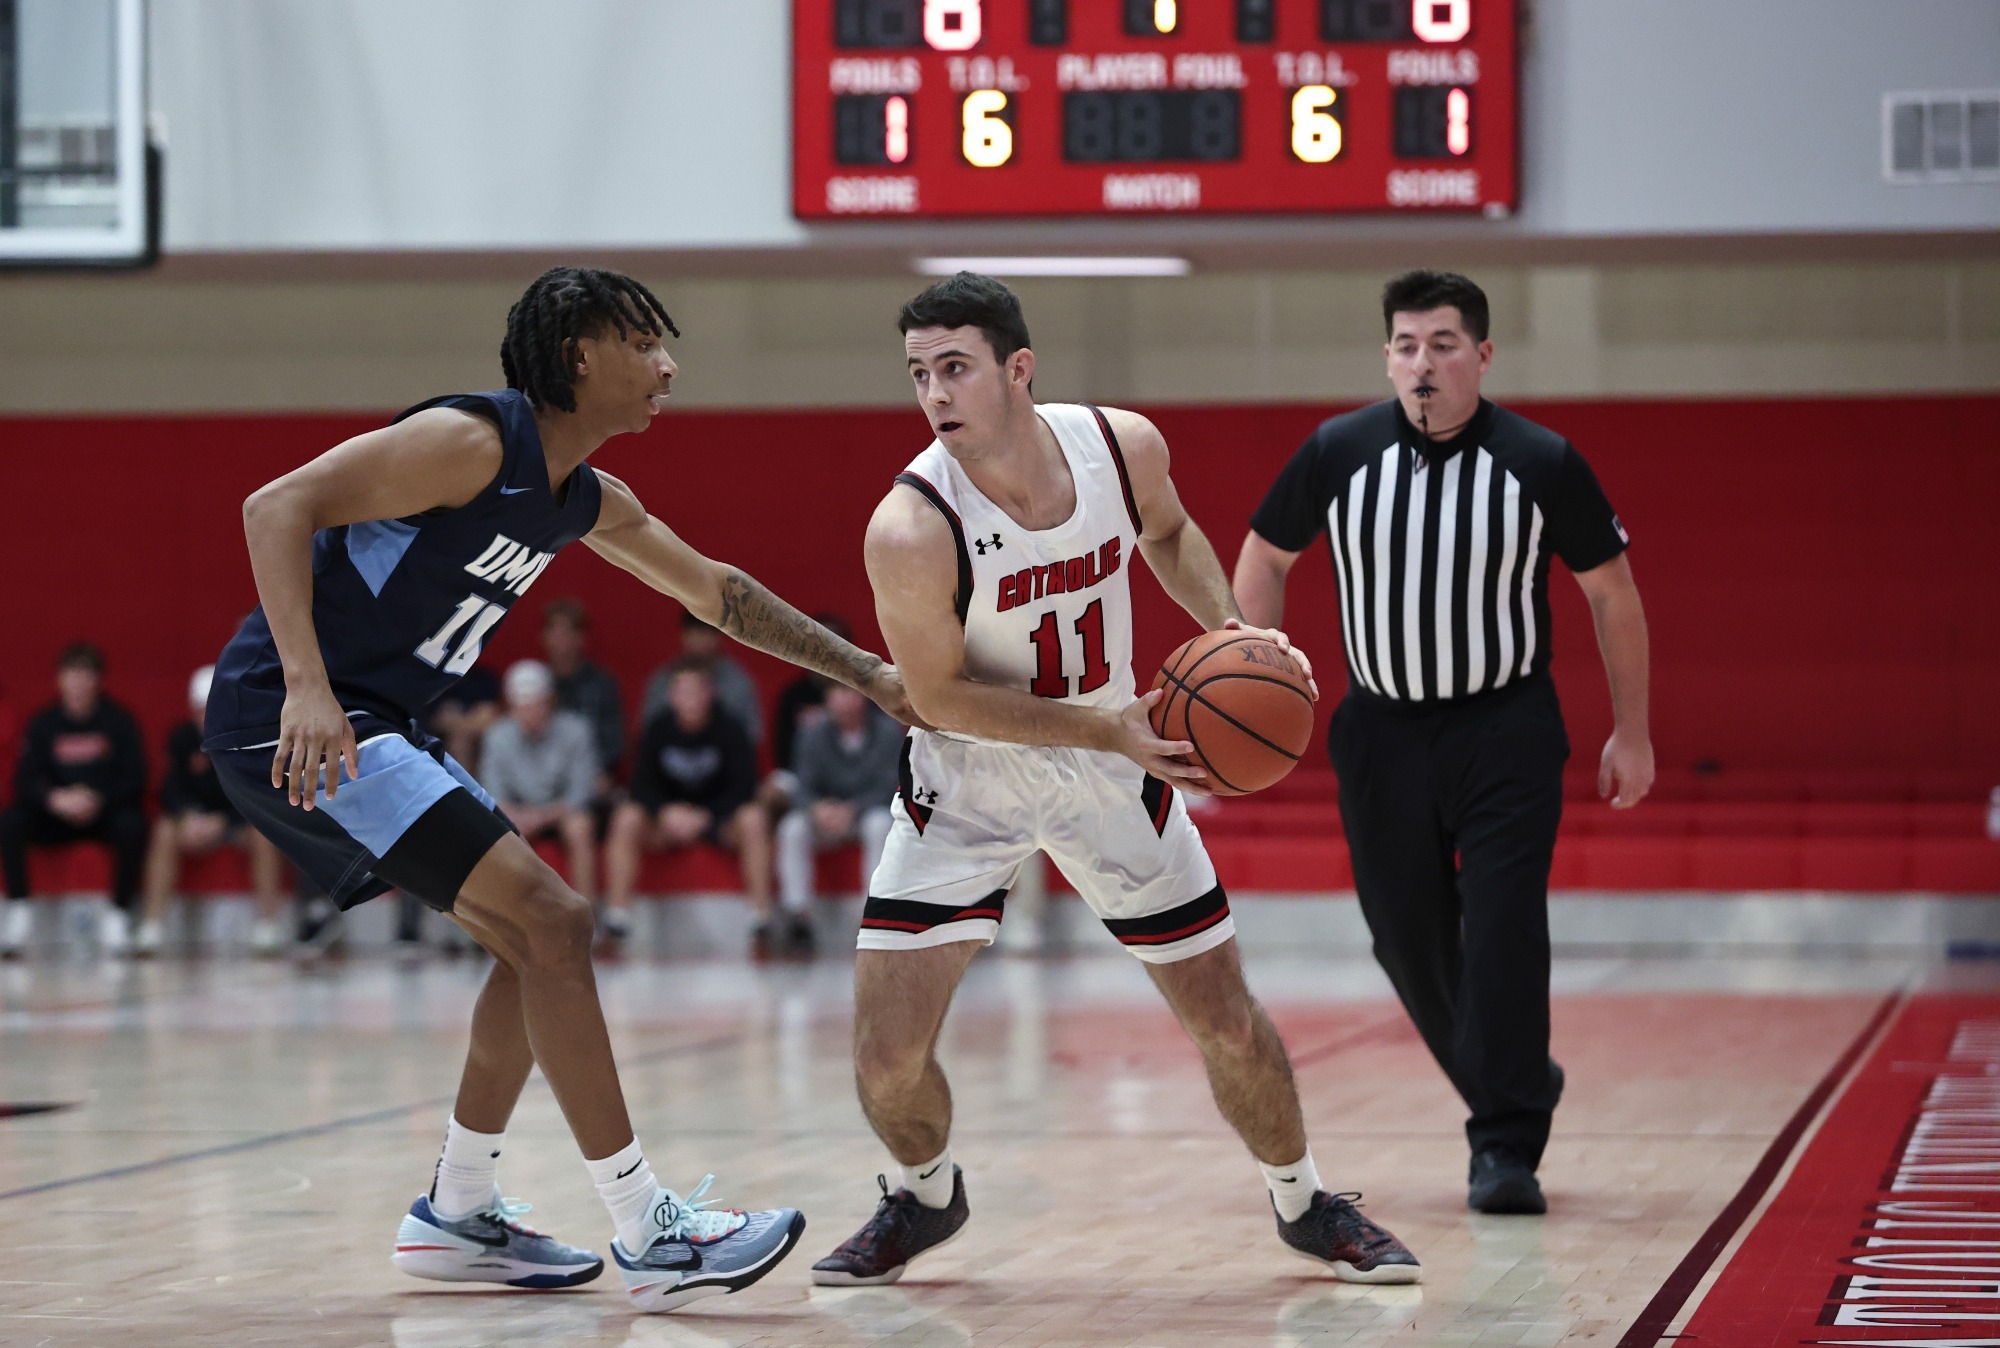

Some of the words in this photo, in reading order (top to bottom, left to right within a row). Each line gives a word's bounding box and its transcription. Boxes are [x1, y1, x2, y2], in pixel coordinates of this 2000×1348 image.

[830, 58, 922, 94] FOULS
[1057, 54, 1168, 91] PLAYER
[1173, 53, 1248, 89] FOUL
[1387, 50, 1478, 86] FOULS
[885, 95, 908, 163] 1
[962, 90, 1012, 167] 6
[1291, 84, 1342, 163] 6
[1447, 88, 1469, 156] 1
[827, 176, 918, 213] SCORE
[1103, 173, 1200, 210] MATCH
[1387, 169, 1478, 206] SCORE
[997, 535, 1121, 612] CATHOLIC
[1029, 597, 1110, 698] 11
